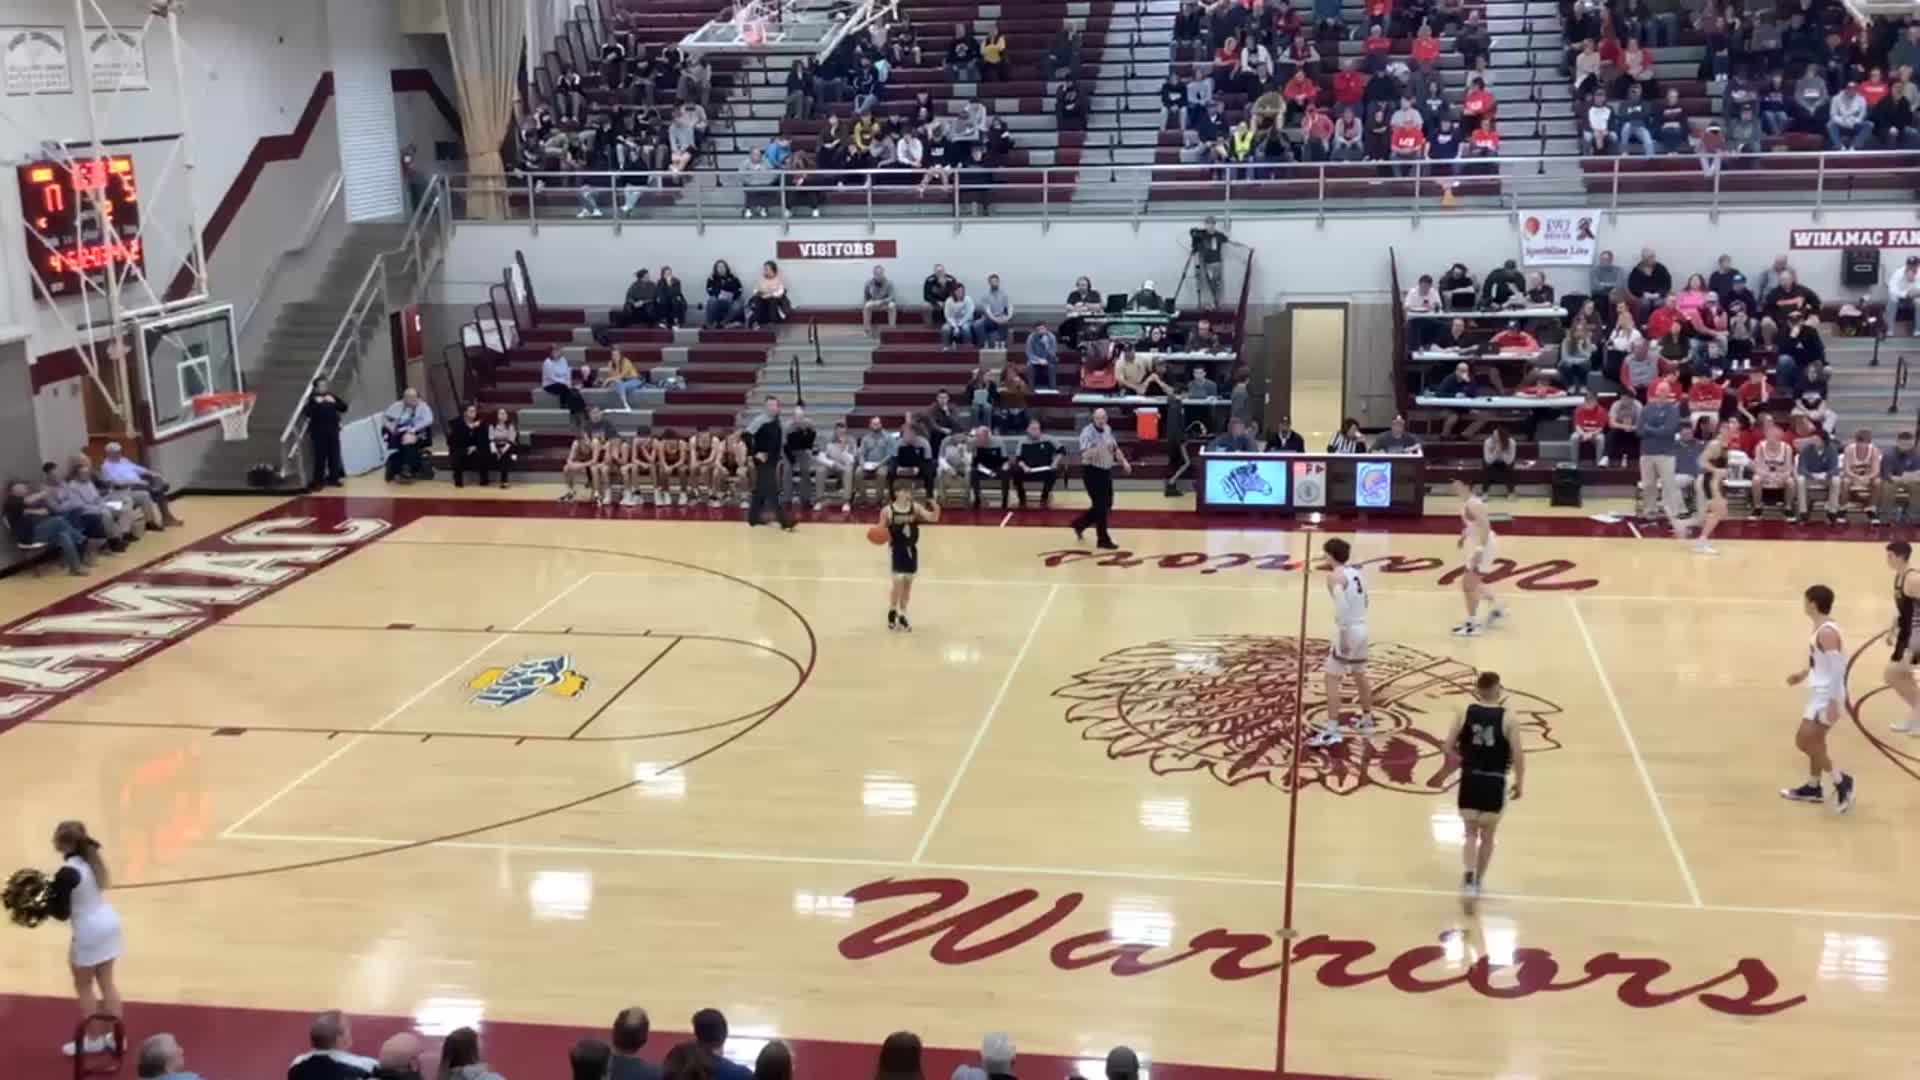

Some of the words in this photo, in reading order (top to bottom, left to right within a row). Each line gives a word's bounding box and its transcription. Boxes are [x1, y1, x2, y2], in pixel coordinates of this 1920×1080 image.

[1793, 230, 1884, 247] WINAMAC
[798, 243, 875, 257] VISITORS
[1471, 723, 1496, 747] 24
[837, 877, 1808, 1017] Warriors
